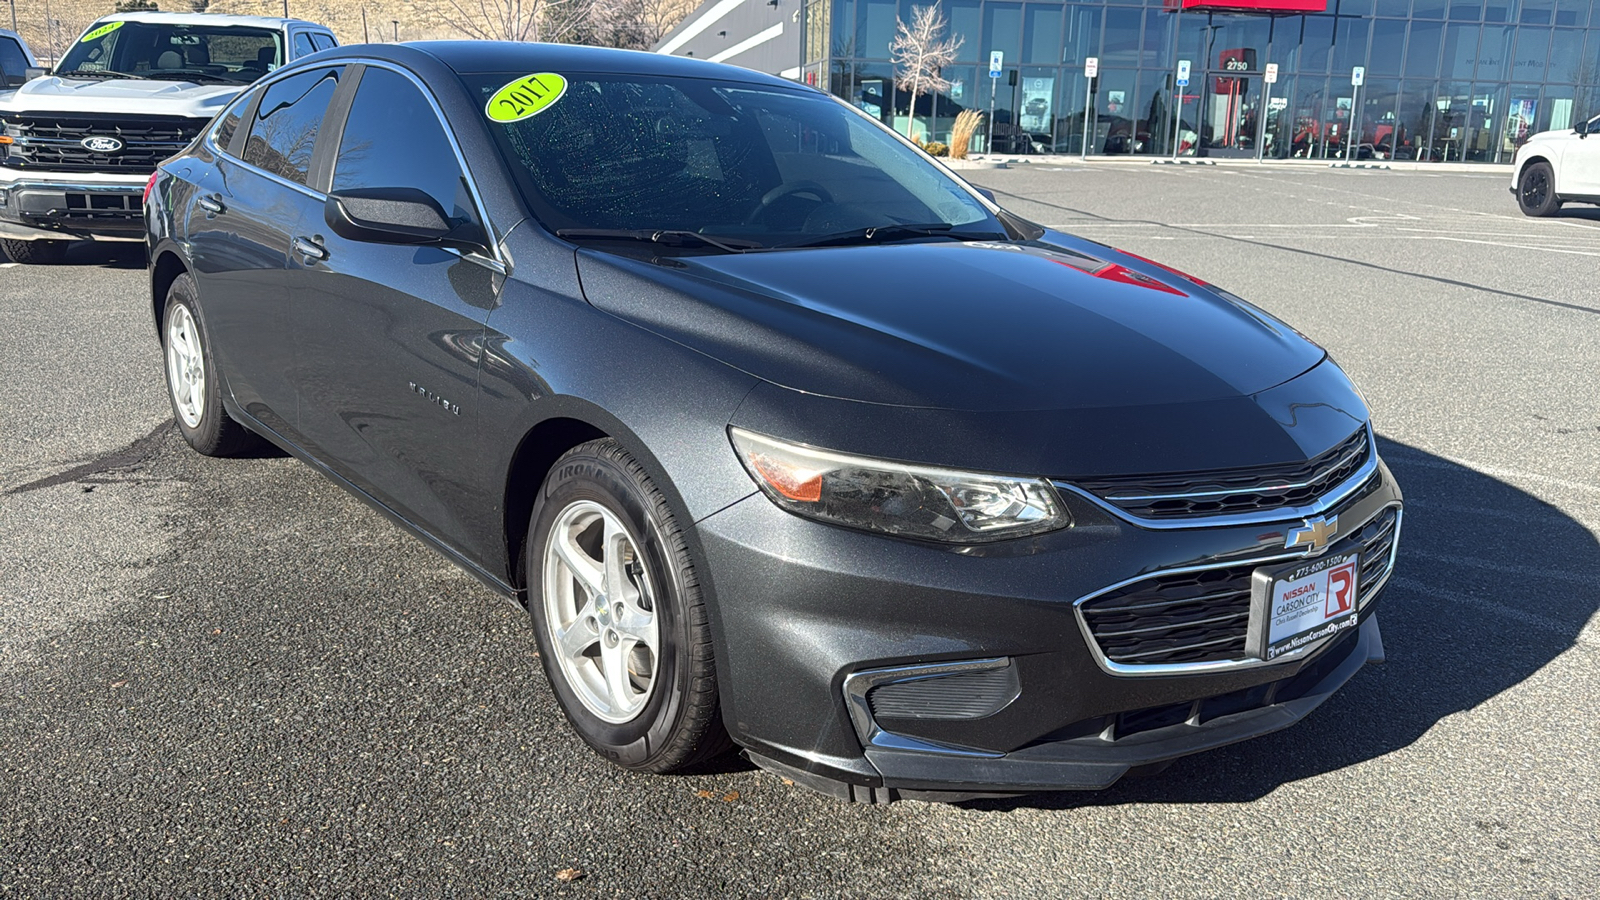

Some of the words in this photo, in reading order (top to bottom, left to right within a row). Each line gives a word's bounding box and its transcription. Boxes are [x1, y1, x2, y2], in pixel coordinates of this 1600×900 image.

[1227, 61, 1248, 70] 2750
[499, 76, 551, 116] 2017
[90, 138, 115, 149] Ford
[408, 381, 460, 416] MALIBU
[1296, 555, 1342, 577] 775-600-1500
[1283, 583, 1315, 601] NISSAN
[1277, 598, 1305, 615] CARSON
[1306, 592, 1320, 604] CITY
[1275, 617, 1286, 626] Chris
[1286, 612, 1299, 621] Russell
[1299, 606, 1318, 617] Dealership
[1275, 621, 1350, 655] www.NissanCarsonCity.com
